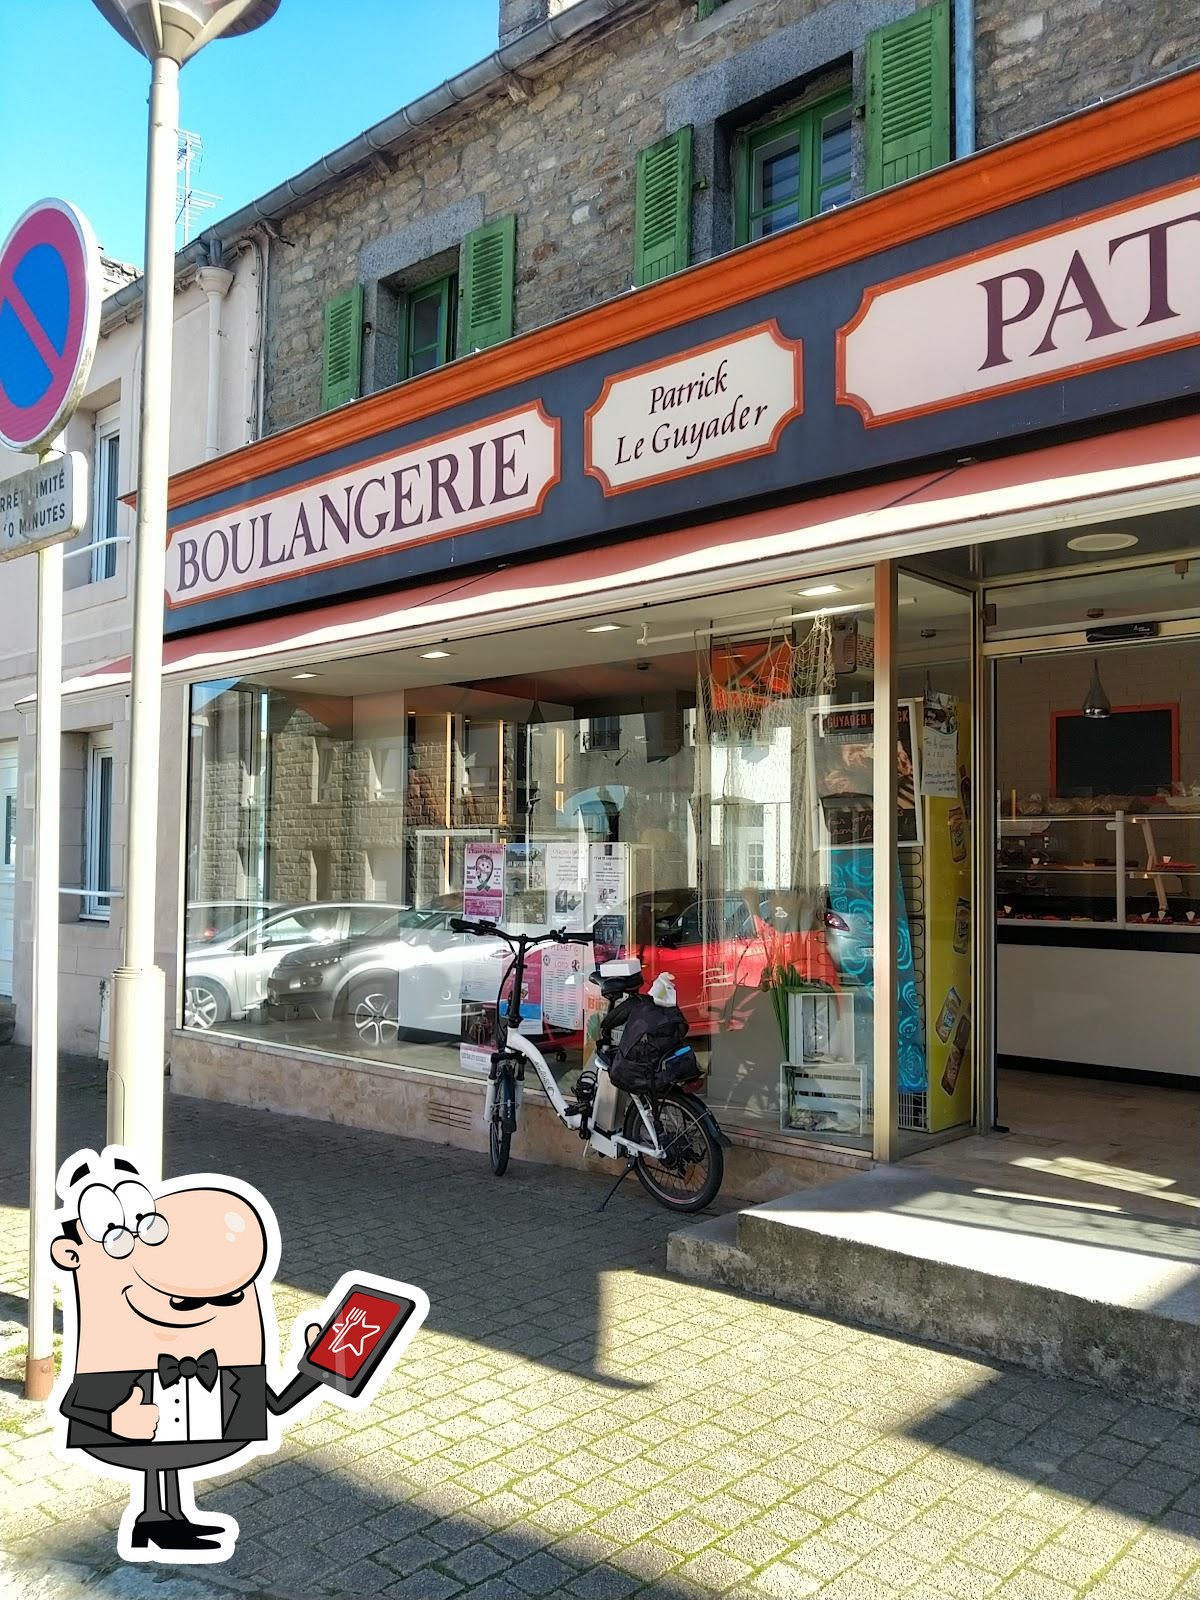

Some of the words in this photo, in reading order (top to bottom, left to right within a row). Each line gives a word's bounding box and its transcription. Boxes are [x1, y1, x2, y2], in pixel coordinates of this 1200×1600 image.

[977, 212, 1200, 371] PAT
[649, 360, 728, 414] Patrick
[615, 435, 645, 466] Le
[651, 405, 768, 460] Guyader
[19, 502, 65, 535] MINUTES
[178, 430, 529, 592] BOULANGERIE
